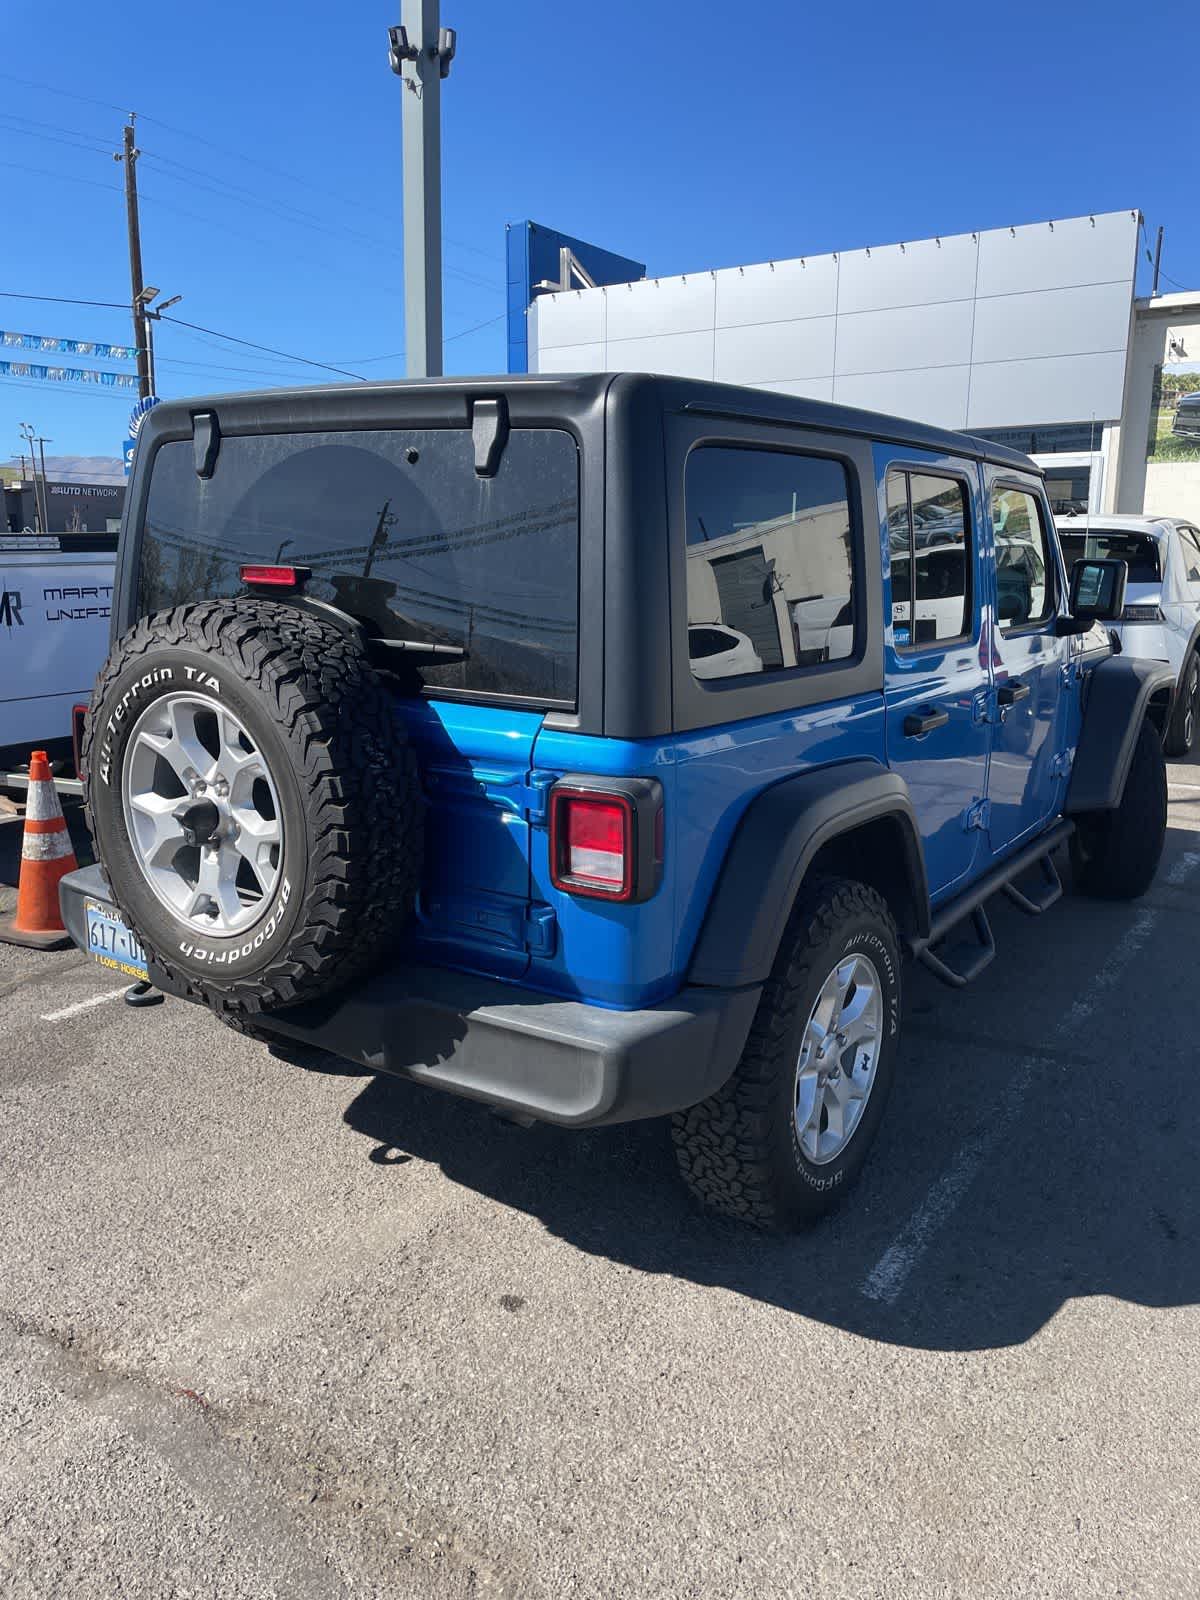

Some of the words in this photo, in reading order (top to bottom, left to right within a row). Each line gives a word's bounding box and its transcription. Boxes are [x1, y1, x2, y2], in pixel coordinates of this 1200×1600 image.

[82, 487, 118, 497] NETWORK
[43, 586, 113, 600] MART
[46, 607, 111, 621] UNIFI
[99, 667, 173, 786] All-Terrain
[183, 665, 221, 694] T/A
[179, 877, 291, 965] BFGoodrich
